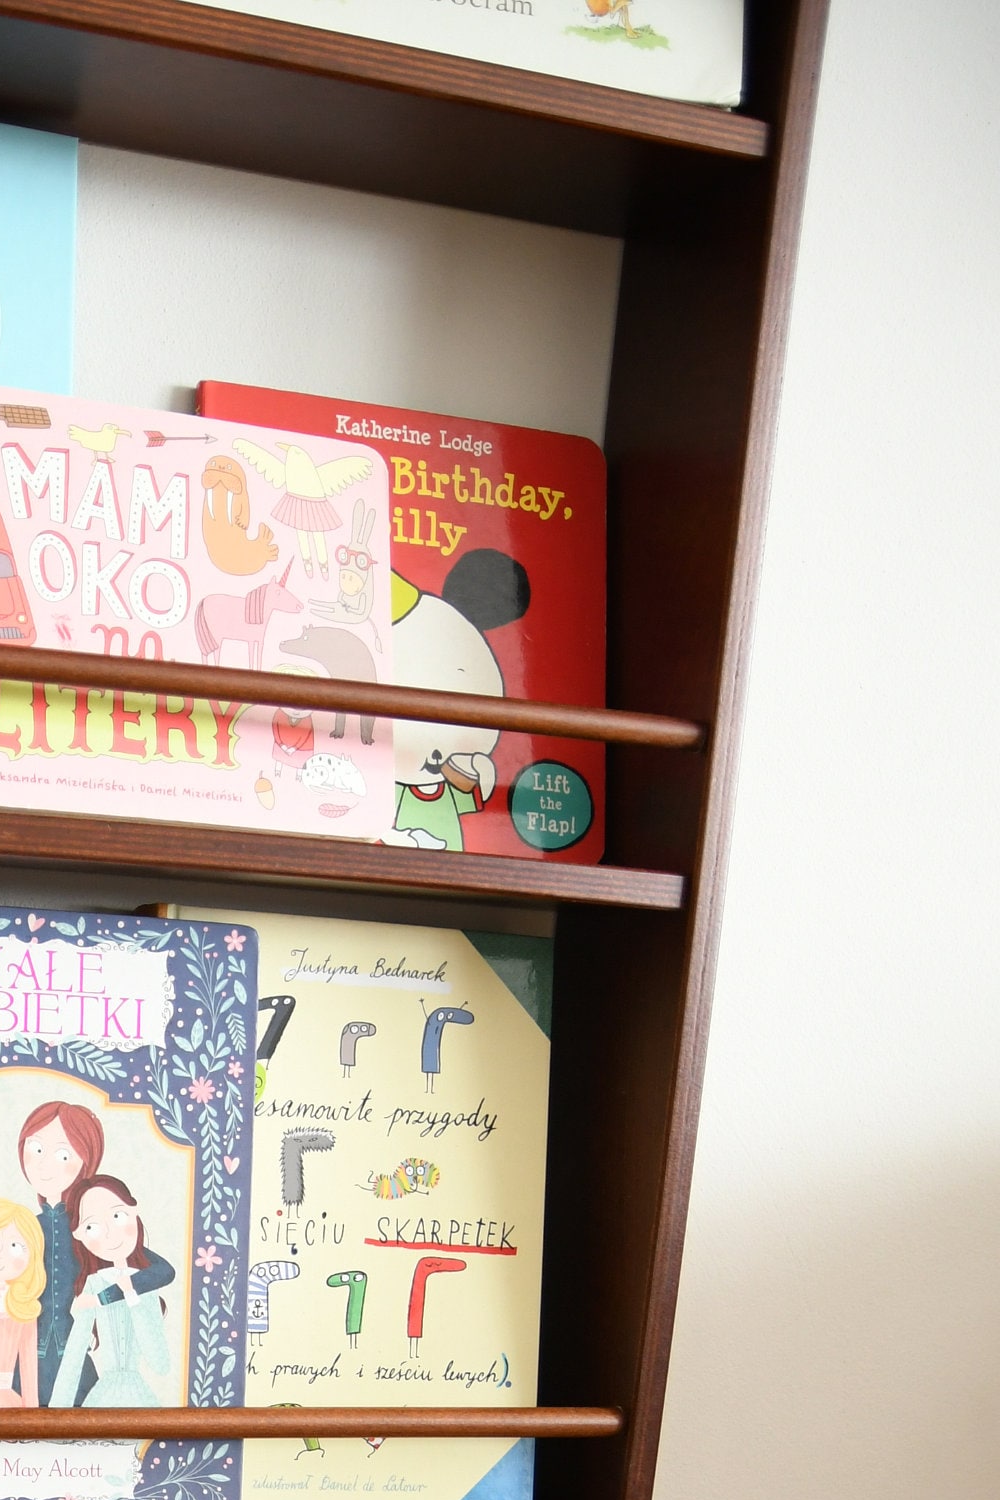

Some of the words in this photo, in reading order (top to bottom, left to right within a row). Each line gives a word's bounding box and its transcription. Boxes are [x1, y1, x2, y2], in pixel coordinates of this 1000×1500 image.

[335, 414, 431, 446] Katherine
[439, 430, 494, 457] Lodge
[1, 442, 192, 560] MAM
[390, 456, 574, 521] Birthday,
[388, 507, 467, 557] illy
[28, 529, 191, 629] OKO
[56, 777, 127, 792] Mizielińska
[140, 784, 177, 797] Daniel
[182, 788, 243, 803] Mizieliński
[533, 772, 571, 795] Lift
[539, 797, 563, 811] the
[526, 811, 576, 836] Flap!
[284, 948, 358, 983] Justyna
[370, 957, 448, 983] Bednarek
[384, 1097, 499, 1142] przygody
[270, 1353, 341, 1388] prawych
[355, 1361, 364, 1378] i
[2, 1459, 43, 1483] May
[48, 1462, 103, 1479] Alcott
[363, 1478, 374, 1492] de
